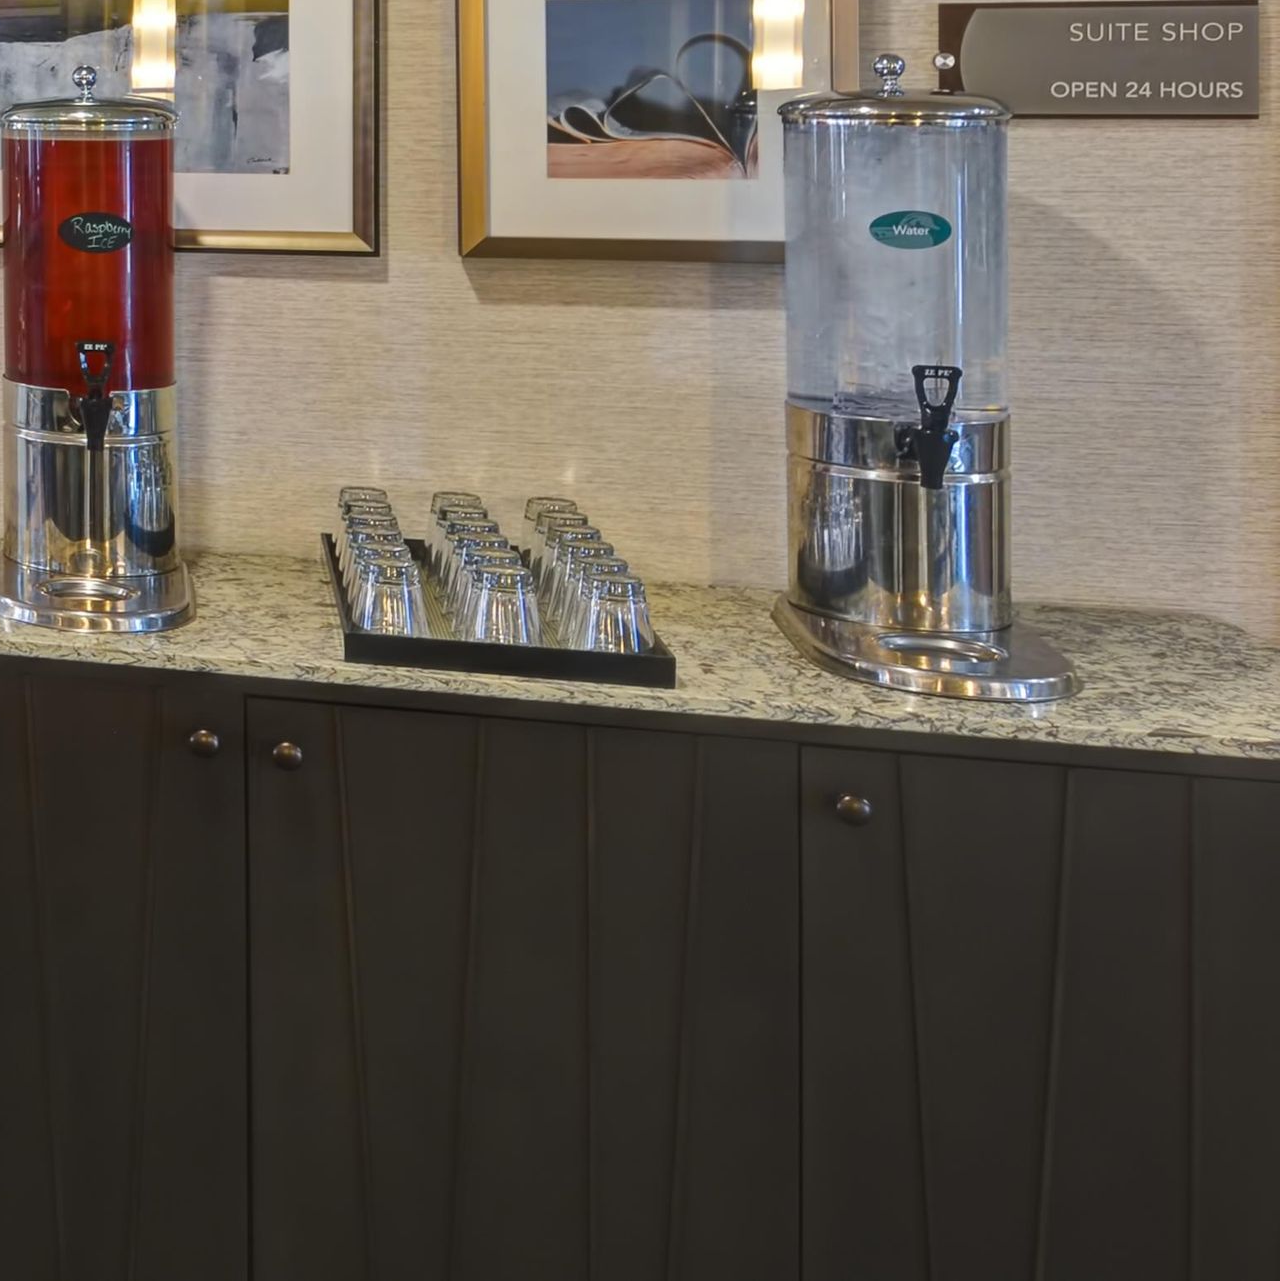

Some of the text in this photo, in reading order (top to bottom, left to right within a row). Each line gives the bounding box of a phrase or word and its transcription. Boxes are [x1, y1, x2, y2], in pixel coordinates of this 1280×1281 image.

[1069, 23, 1244, 41] SUITE SHOP
[1050, 82, 1244, 98] OPEN 24 HOURS
[71, 217, 131, 238] Raspberry
[893, 224, 929, 236] Water
